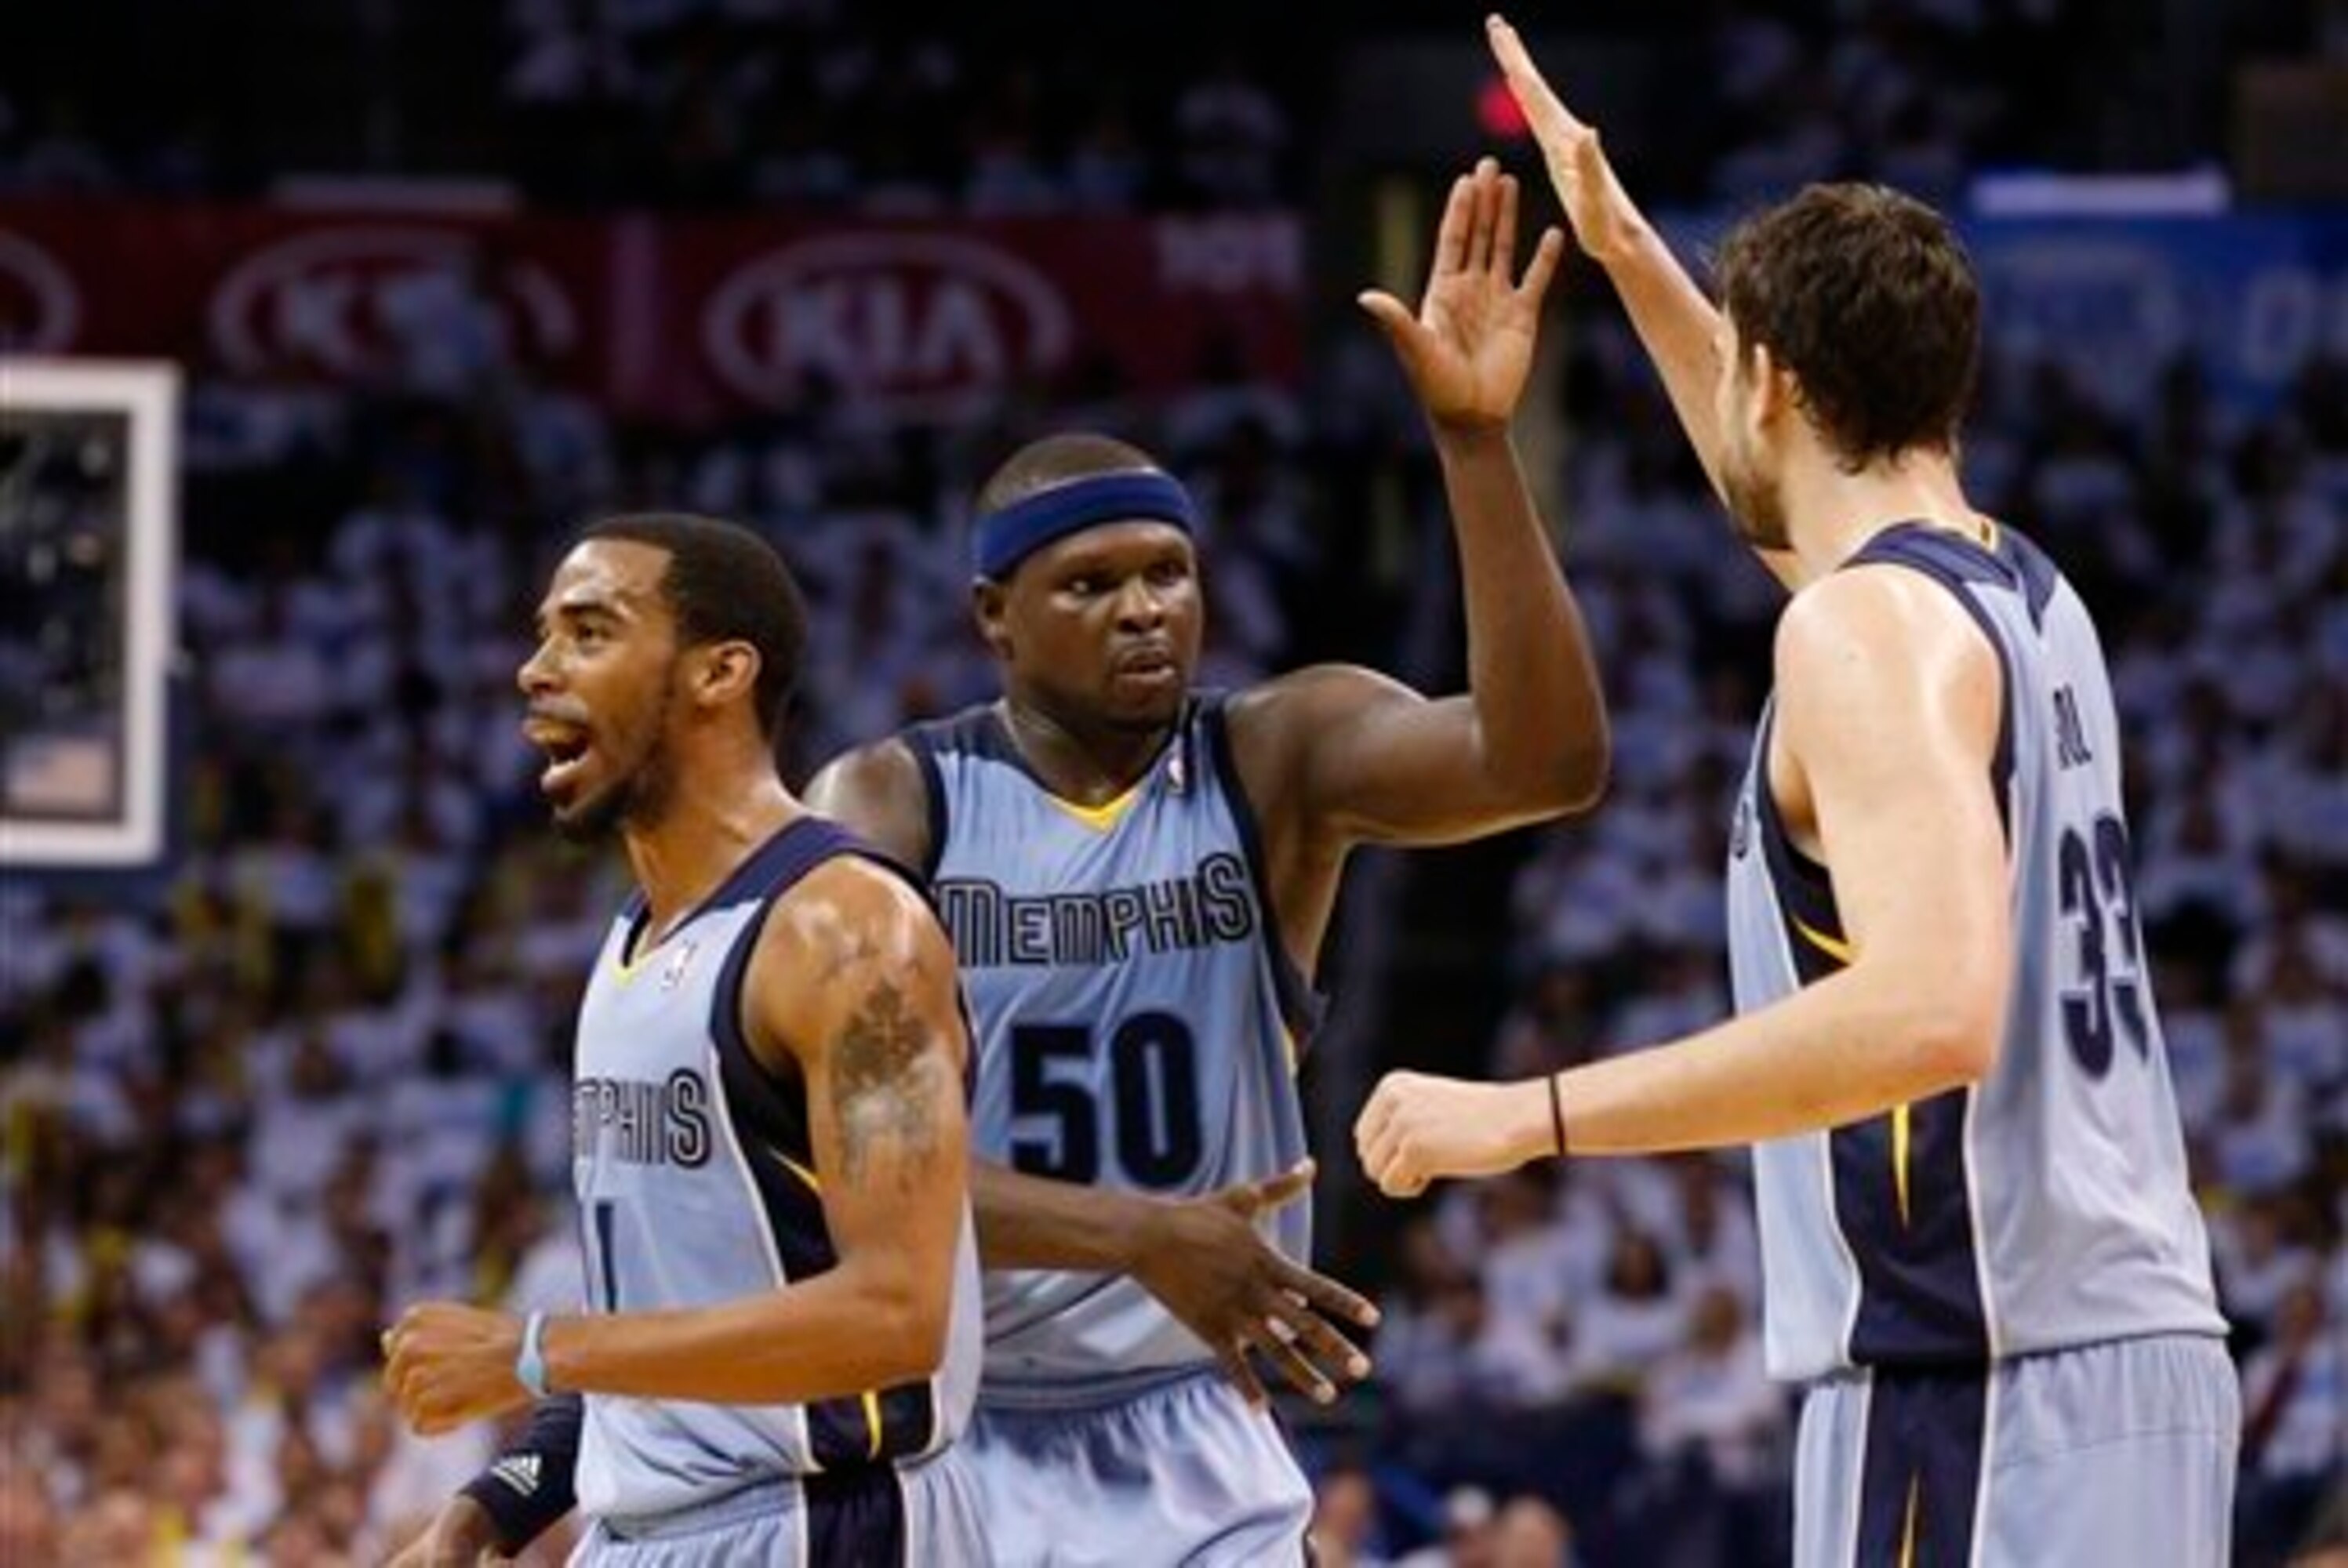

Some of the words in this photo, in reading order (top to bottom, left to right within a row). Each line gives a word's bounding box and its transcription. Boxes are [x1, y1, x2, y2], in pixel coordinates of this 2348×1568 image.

[775, 276, 1005, 371] KIA
[940, 854, 1254, 967] MEMPHIS
[1010, 1013, 1201, 1188] 50
